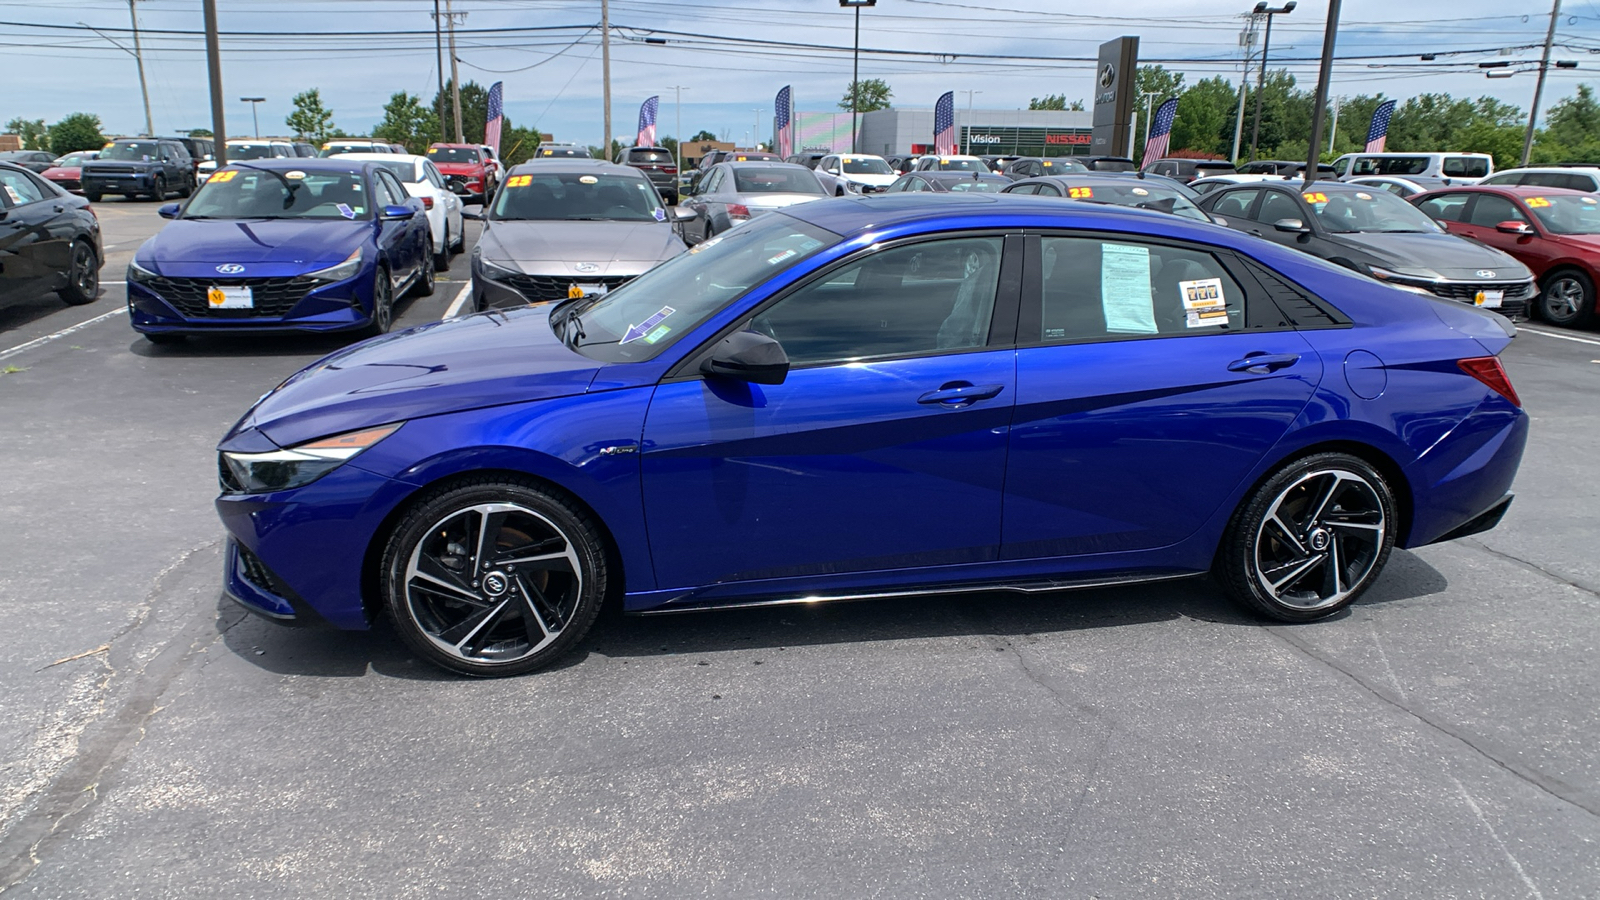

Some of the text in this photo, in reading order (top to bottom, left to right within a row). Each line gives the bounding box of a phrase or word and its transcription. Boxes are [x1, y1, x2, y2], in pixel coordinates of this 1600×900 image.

[971, 134, 1001, 144] Vision
[207, 171, 239, 183] 23
[507, 175, 533, 187] 23
[1068, 187, 1093, 198] 23
[1303, 192, 1329, 204] 24
[1525, 197, 1552, 208] 25
[212, 293, 222, 301] M
